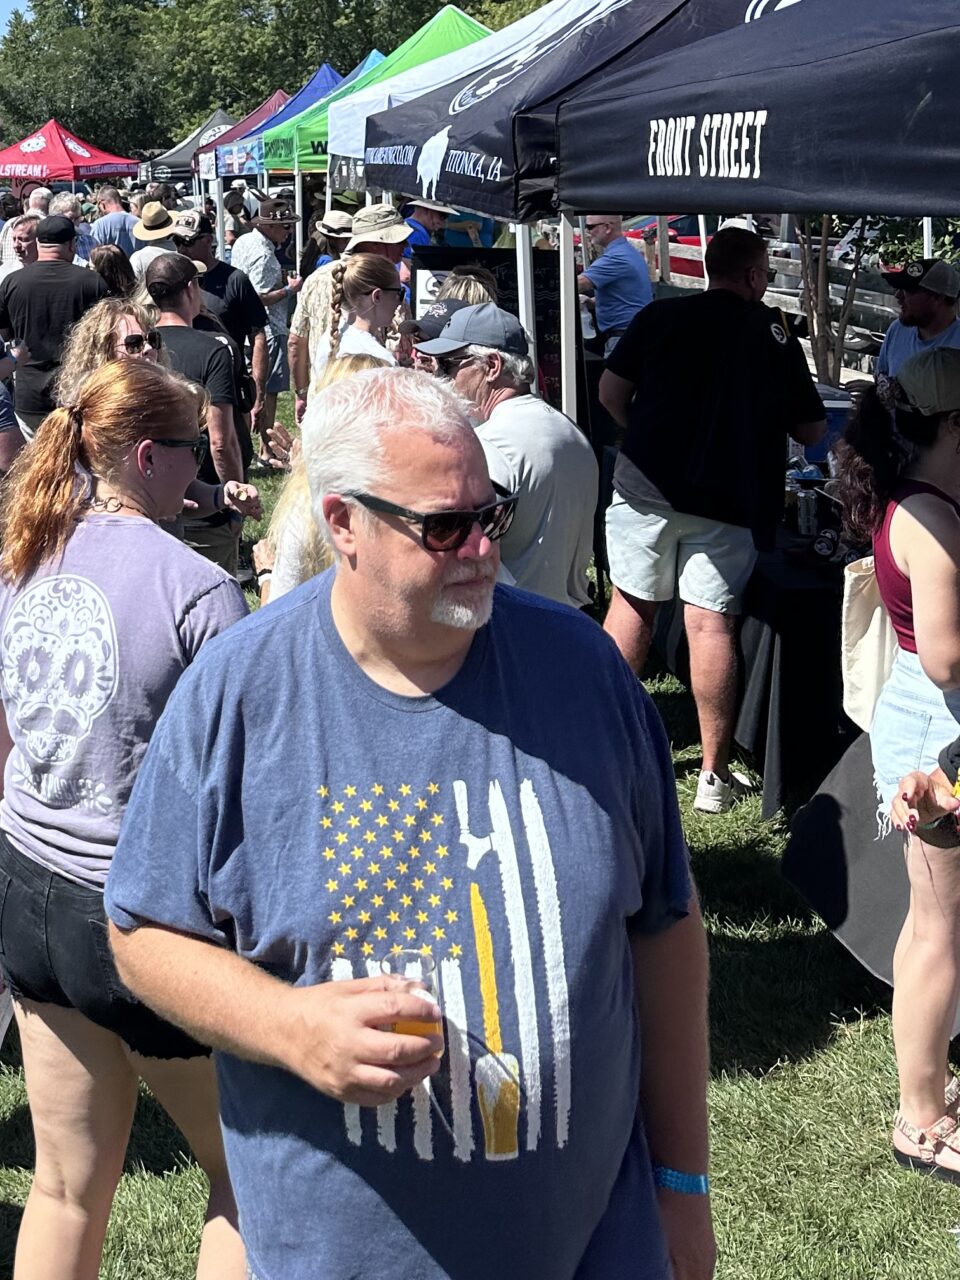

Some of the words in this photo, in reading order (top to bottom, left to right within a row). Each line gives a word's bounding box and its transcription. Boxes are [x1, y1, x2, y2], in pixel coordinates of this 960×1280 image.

[648, 115, 696, 177] FRONT
[699, 110, 768, 179] STREET
[487, 156, 502, 182] IA
